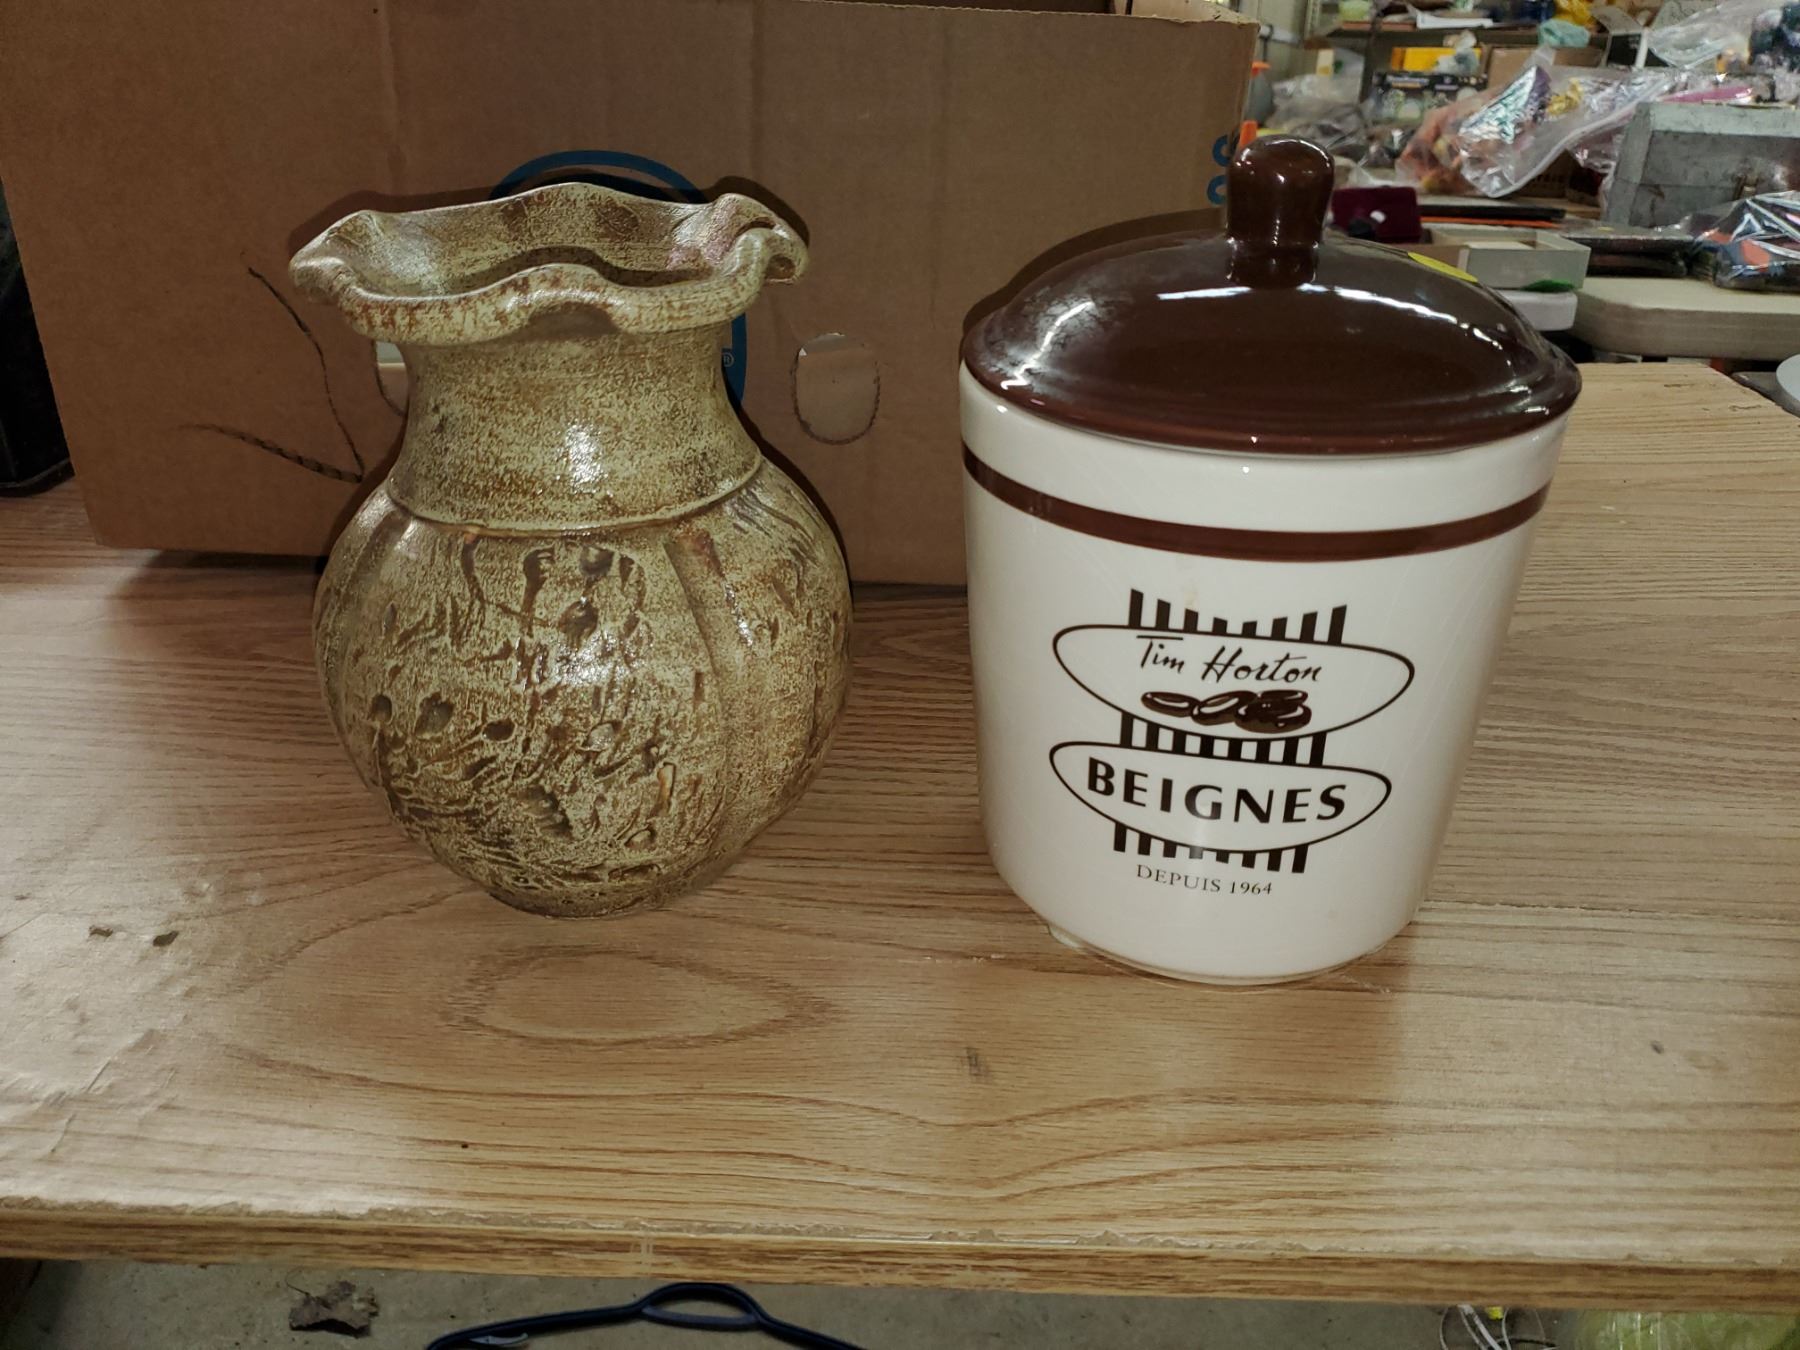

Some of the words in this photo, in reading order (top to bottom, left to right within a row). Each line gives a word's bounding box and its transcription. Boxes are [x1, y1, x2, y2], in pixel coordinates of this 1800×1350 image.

[1136, 635, 1185, 674] Tim
[1201, 645, 1322, 683] Horton
[1087, 756, 1347, 824] BEIGNES
[1136, 863, 1221, 893] DEPUIS
[1229, 880, 1273, 896] 1964
